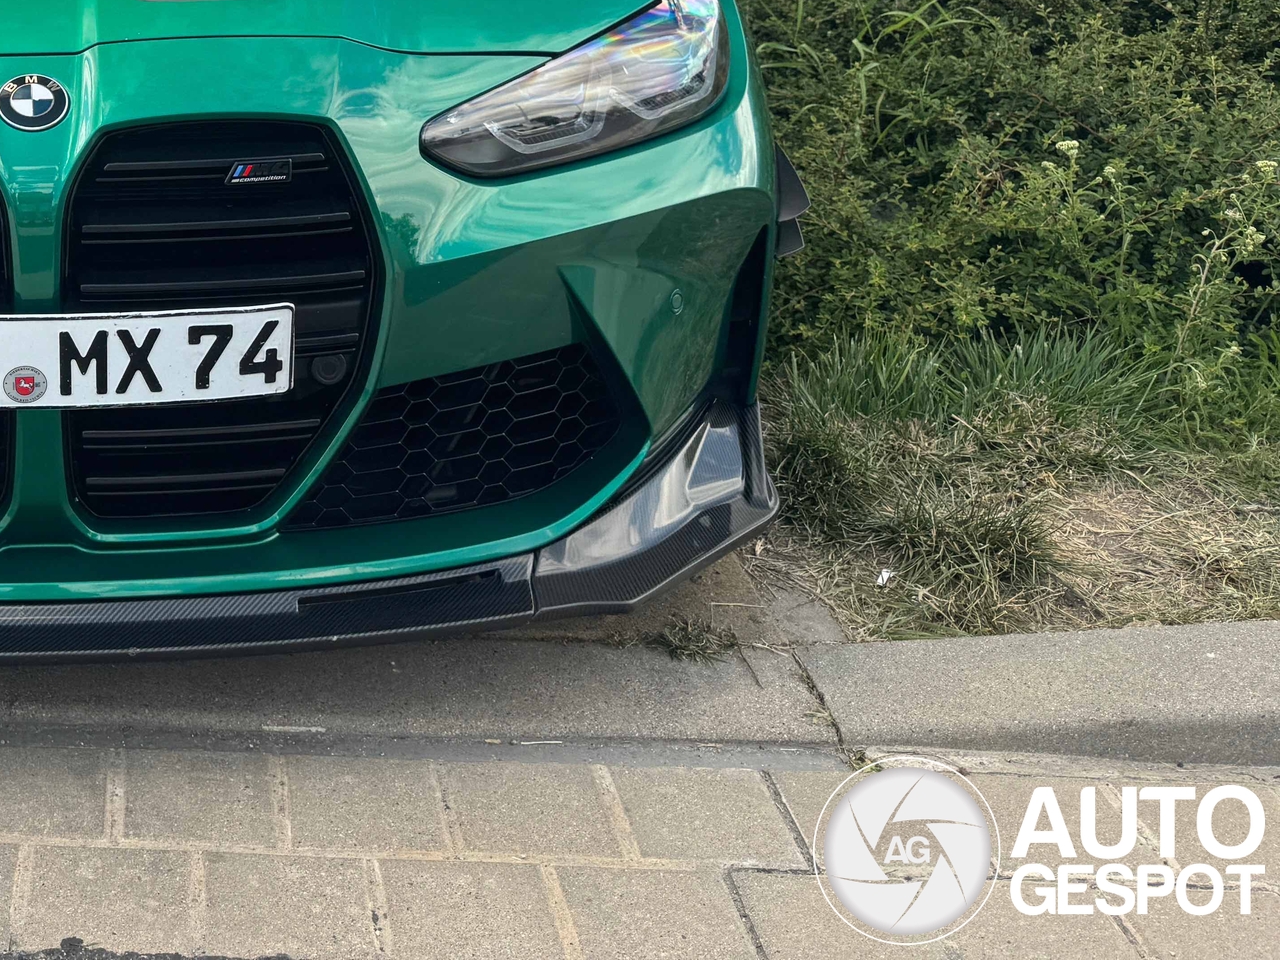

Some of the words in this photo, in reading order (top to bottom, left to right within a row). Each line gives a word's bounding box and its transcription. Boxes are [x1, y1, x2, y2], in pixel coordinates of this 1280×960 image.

[4, 75, 61, 93] BMW
[59, 329, 163, 395] MX
[187, 320, 283, 390] 74
